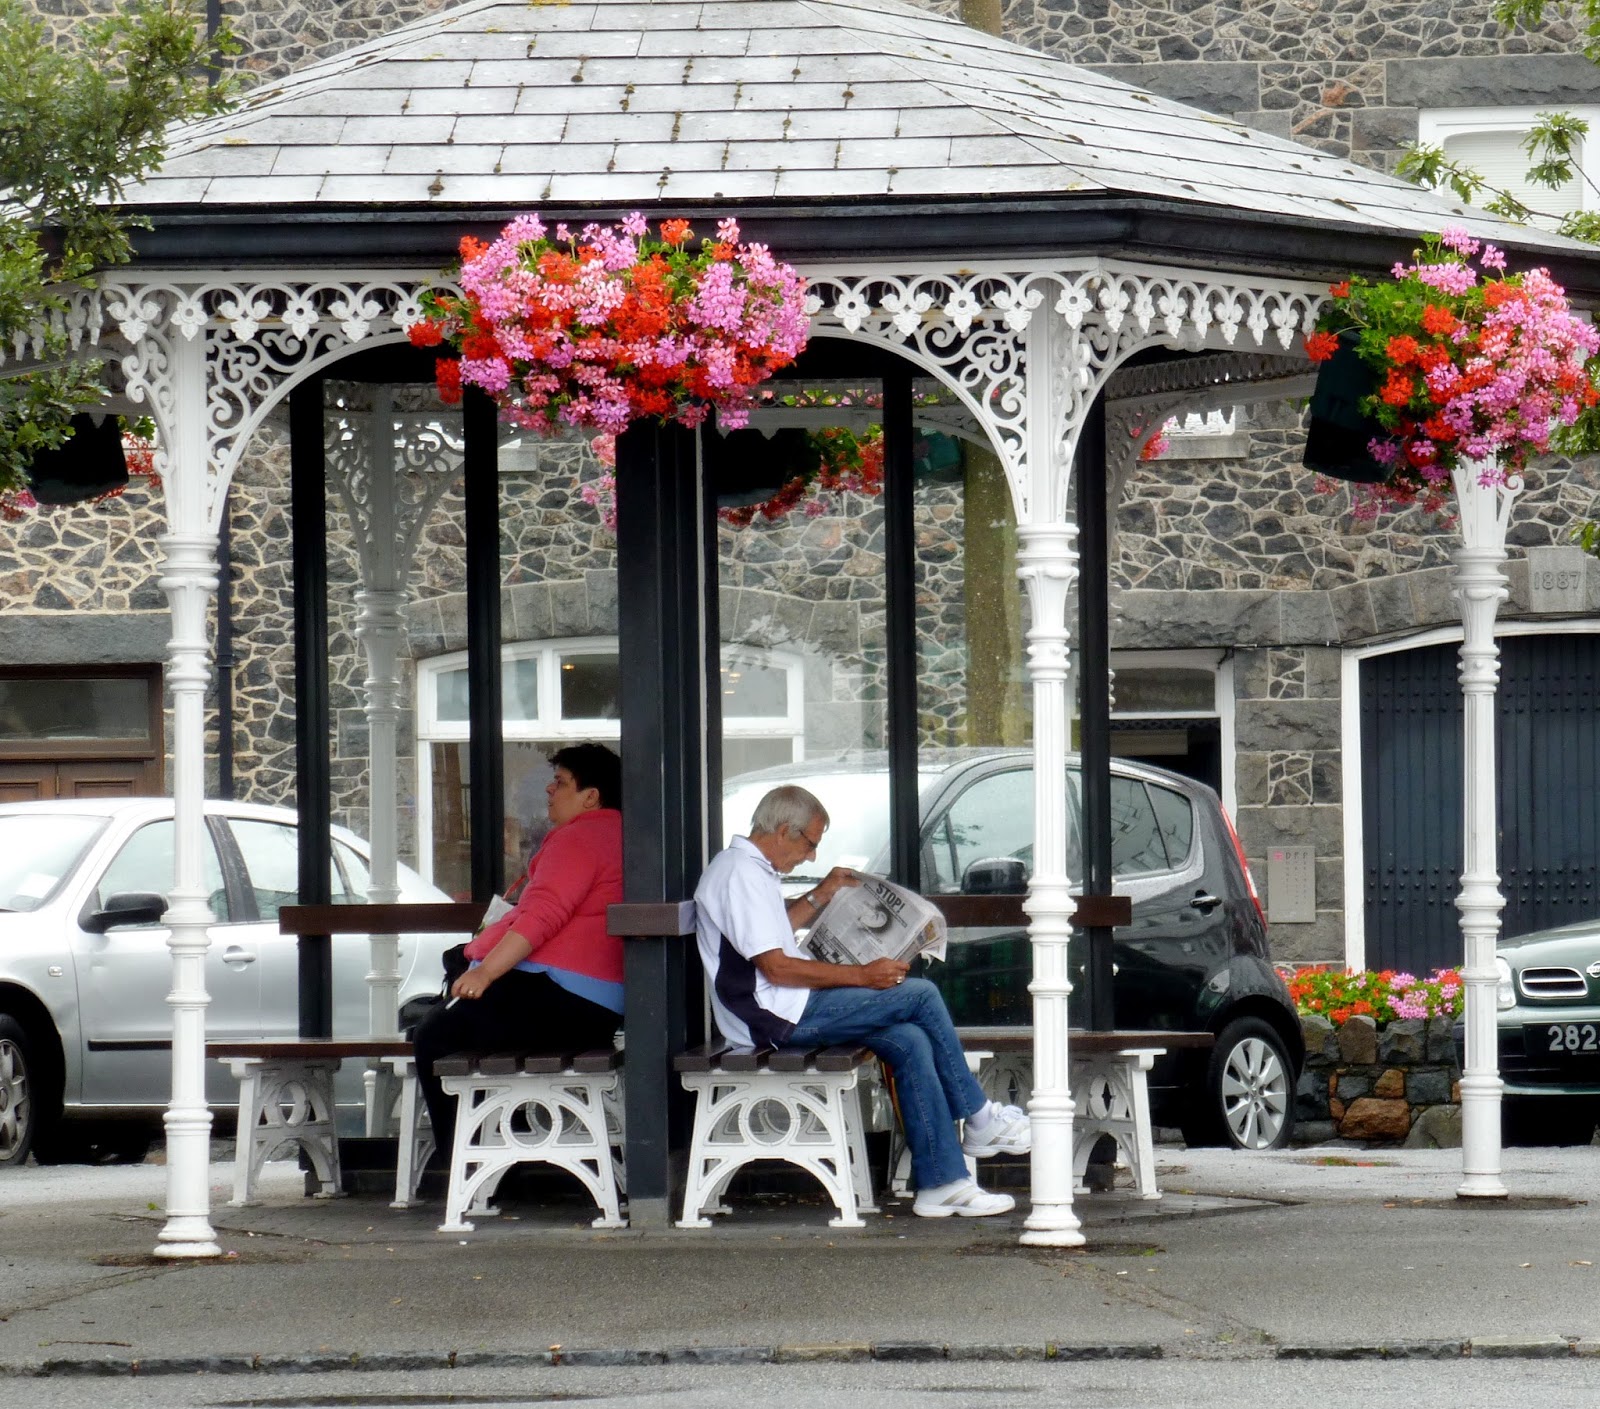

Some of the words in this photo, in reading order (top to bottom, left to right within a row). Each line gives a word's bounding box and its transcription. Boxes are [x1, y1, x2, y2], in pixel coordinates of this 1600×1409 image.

[1534, 571, 1580, 590] 1887
[876, 883, 905, 913] STOP!
[1547, 1024, 1600, 1051] 282
